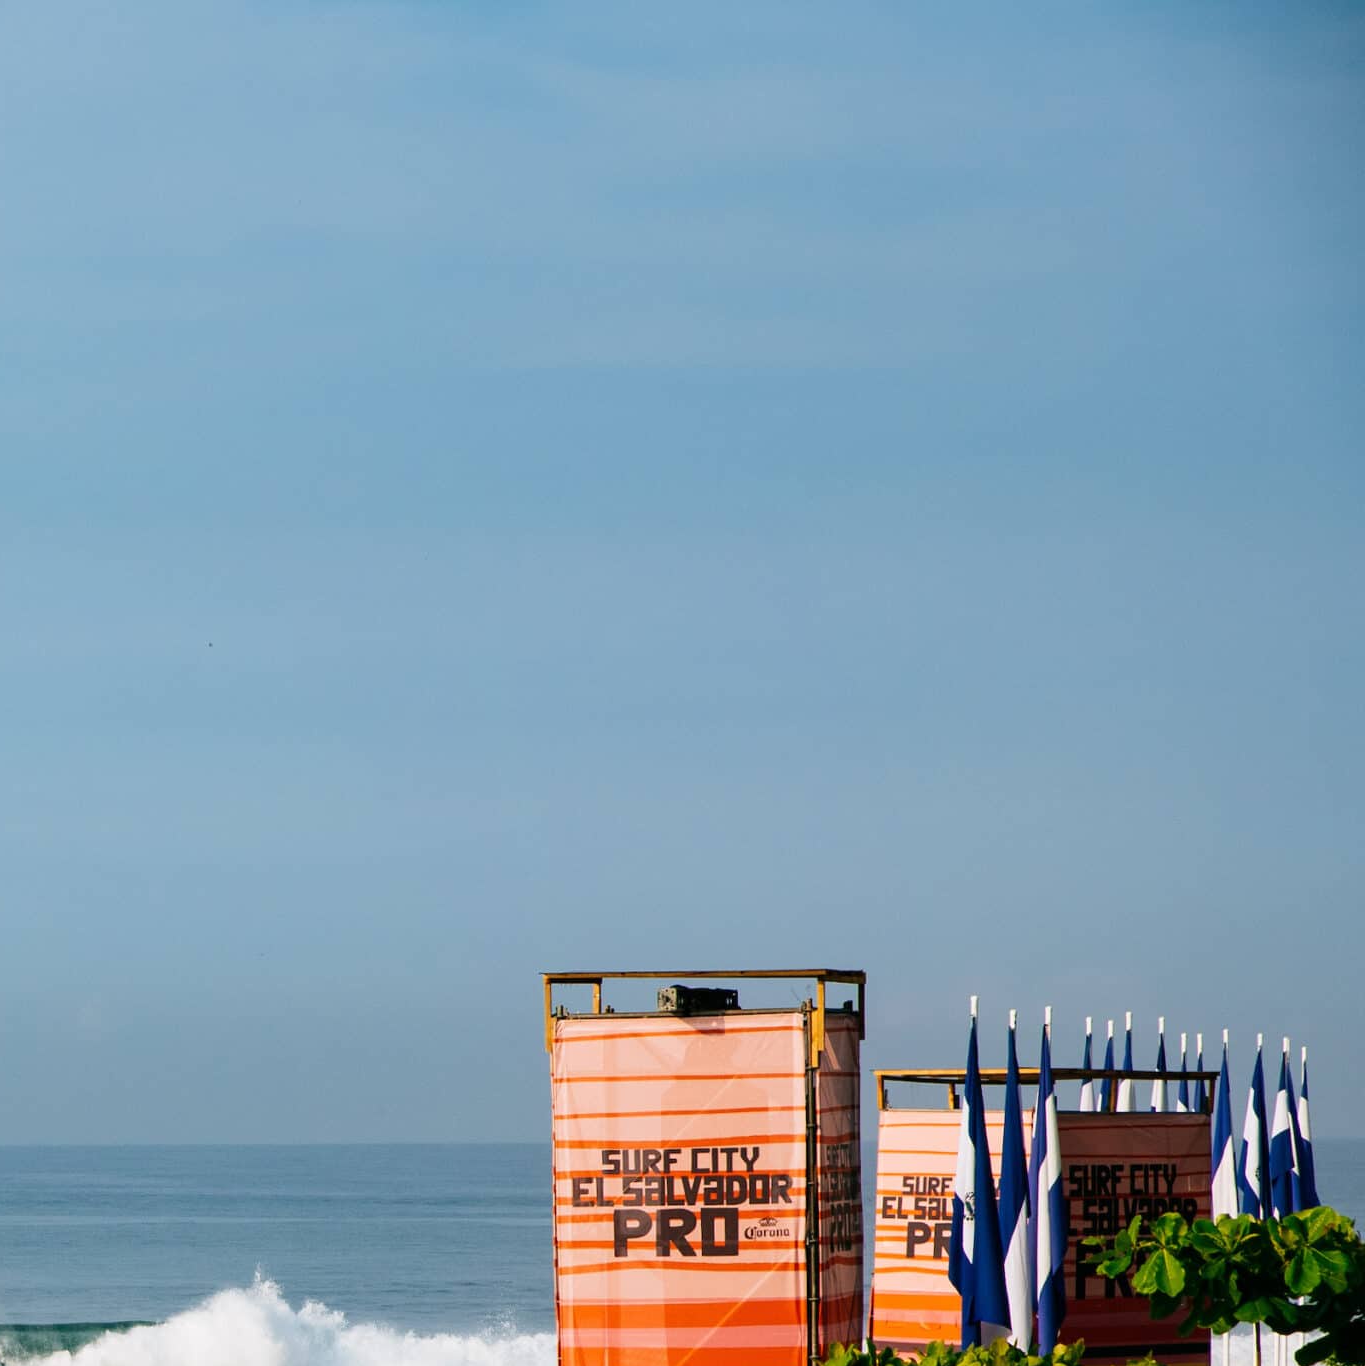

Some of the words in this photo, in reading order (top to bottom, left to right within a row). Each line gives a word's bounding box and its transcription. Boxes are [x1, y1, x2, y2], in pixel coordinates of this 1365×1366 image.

[601, 1148, 682, 1175] SURF
[691, 1147, 760, 1173] CITY
[572, 1176, 614, 1207] EL
[903, 1176, 953, 1195] SURF
[1069, 1165, 1124, 1197] SURF
[1130, 1164, 1177, 1195] CITY
[882, 1196, 908, 1219] EL
[614, 1207, 739, 1257] PRO
[744, 1226, 789, 1240] Corona
[906, 1222, 952, 1259] PR
